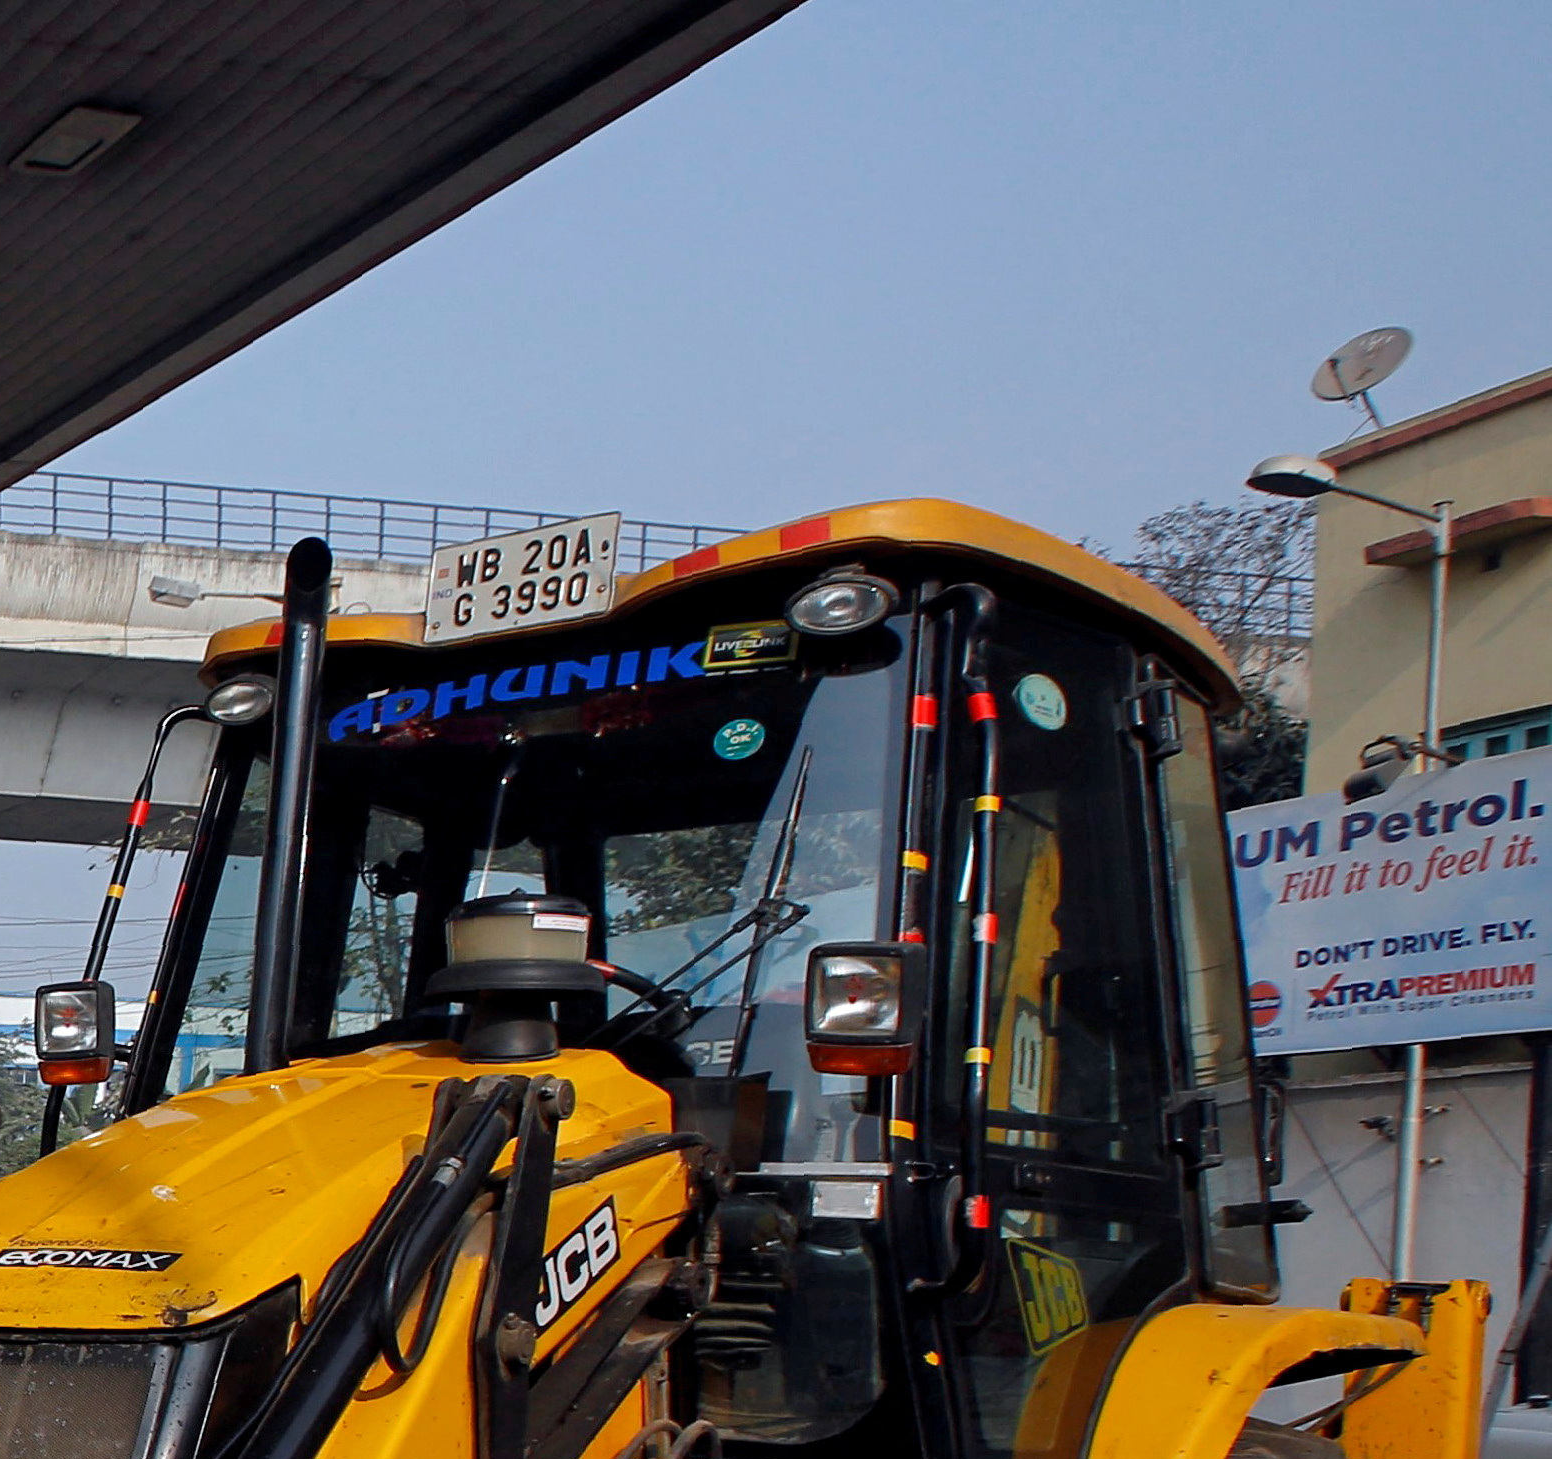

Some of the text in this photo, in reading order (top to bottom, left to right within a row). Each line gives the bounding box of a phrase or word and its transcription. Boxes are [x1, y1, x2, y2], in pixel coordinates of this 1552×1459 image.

[456, 528, 593, 589] WB 20A
[454, 571, 589, 627] G 3990
[328, 641, 709, 743] ADHUNIK
[730, 733, 752, 745] OK
[1340, 779, 1545, 852] Petrol.
[1278, 834, 1539, 904] Fill it to feel it.
[1382, 928, 1472, 957] DRIVE.
[1480, 919, 1537, 945] FLY.
[1307, 962, 1537, 1010] XTRAPREMIUM
[1397, 998, 1444, 1015] Super
[534, 1205, 618, 1328] JCB
[1020, 1251, 1084, 1342] JCB
